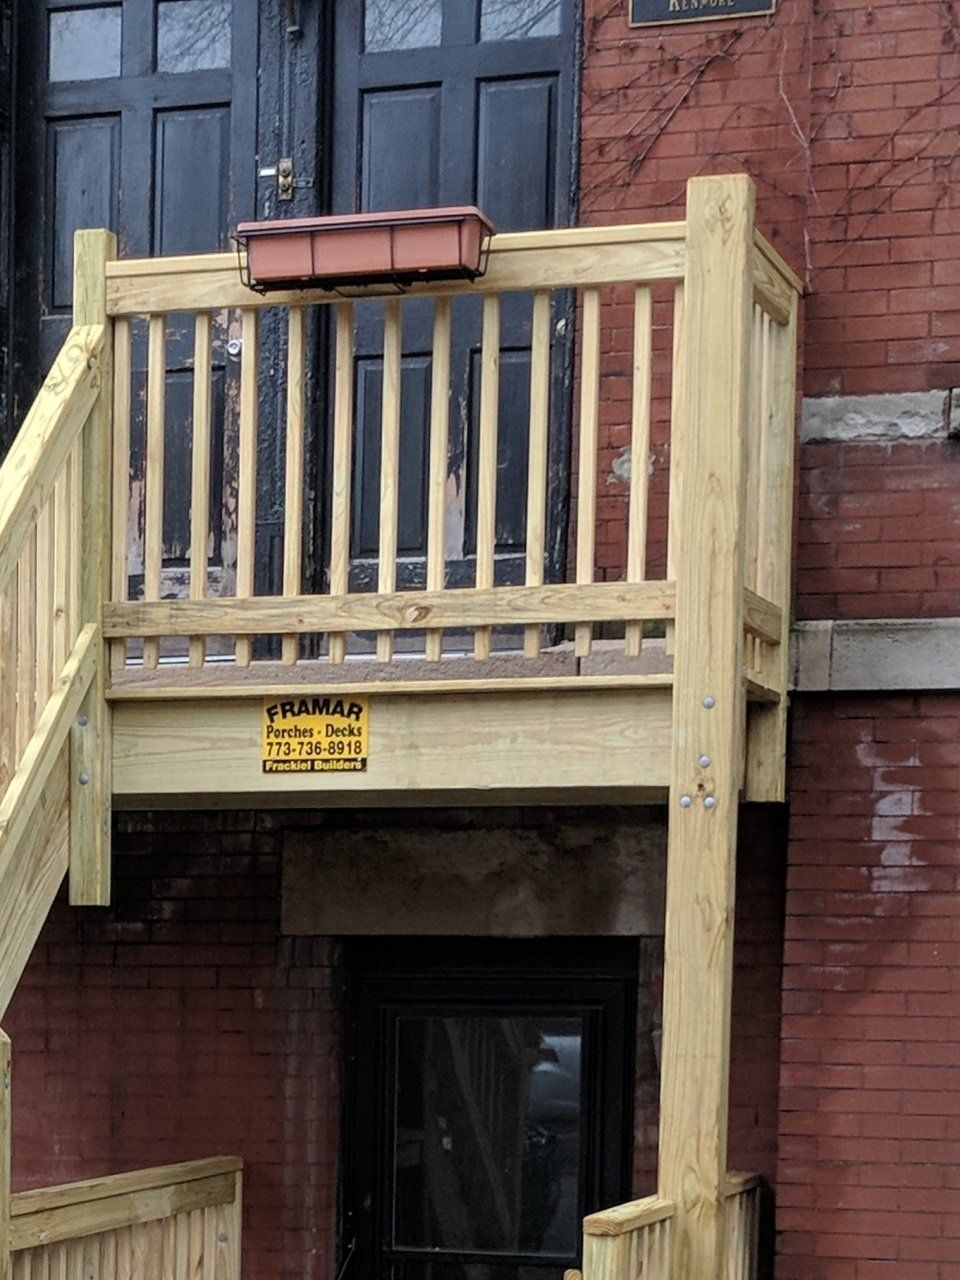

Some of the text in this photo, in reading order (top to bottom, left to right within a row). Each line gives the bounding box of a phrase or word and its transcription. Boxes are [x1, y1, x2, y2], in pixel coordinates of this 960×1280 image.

[266, 698, 363, 723] FRAMAR
[267, 723, 362, 739] Porches Decks
[267, 741, 362, 756] 773-736-8918
[314, 758, 362, 770] Builders
